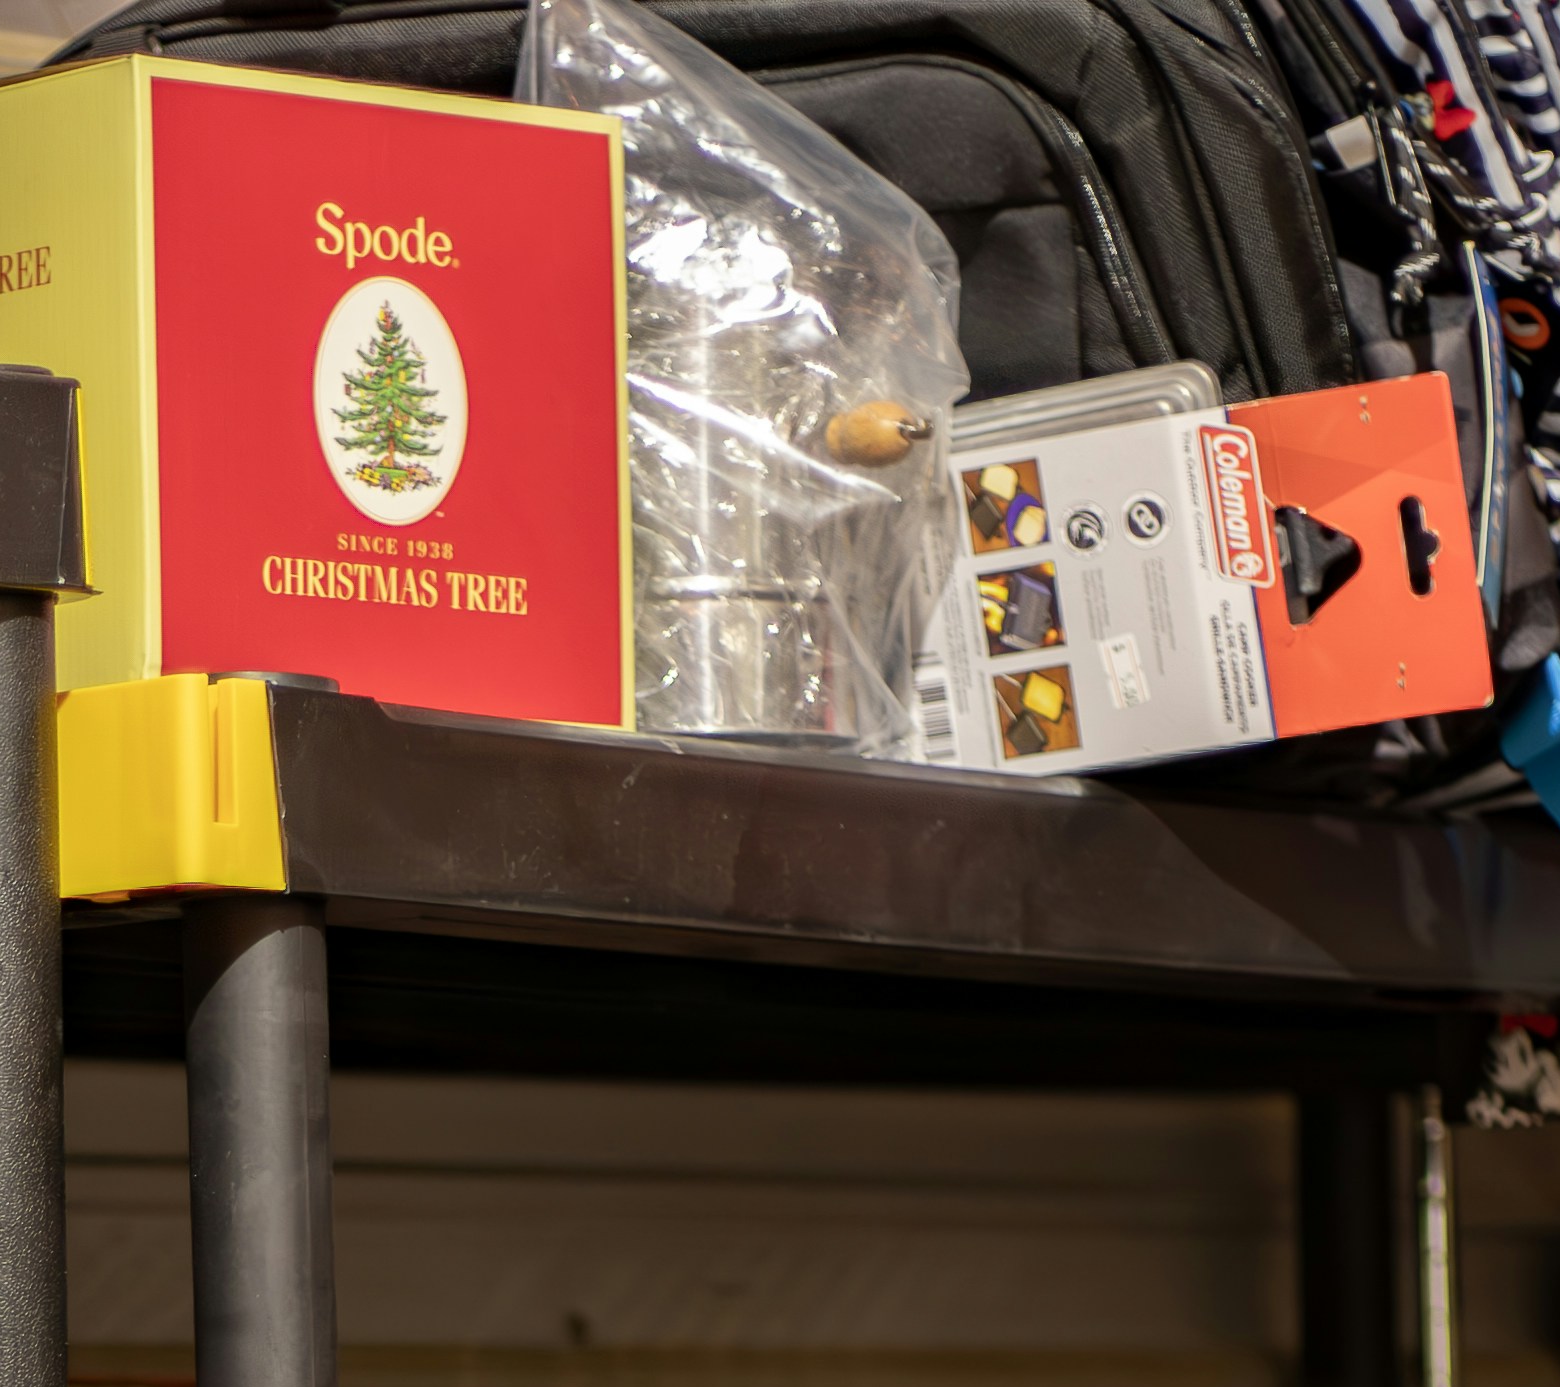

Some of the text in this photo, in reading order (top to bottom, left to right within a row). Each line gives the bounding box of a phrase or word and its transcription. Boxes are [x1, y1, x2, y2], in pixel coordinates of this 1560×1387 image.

[1212, 432, 1253, 552] Coleman
[337, 531, 455, 562] SINCE 1938
[262, 555, 528, 617] CHRISTMAS TREE
